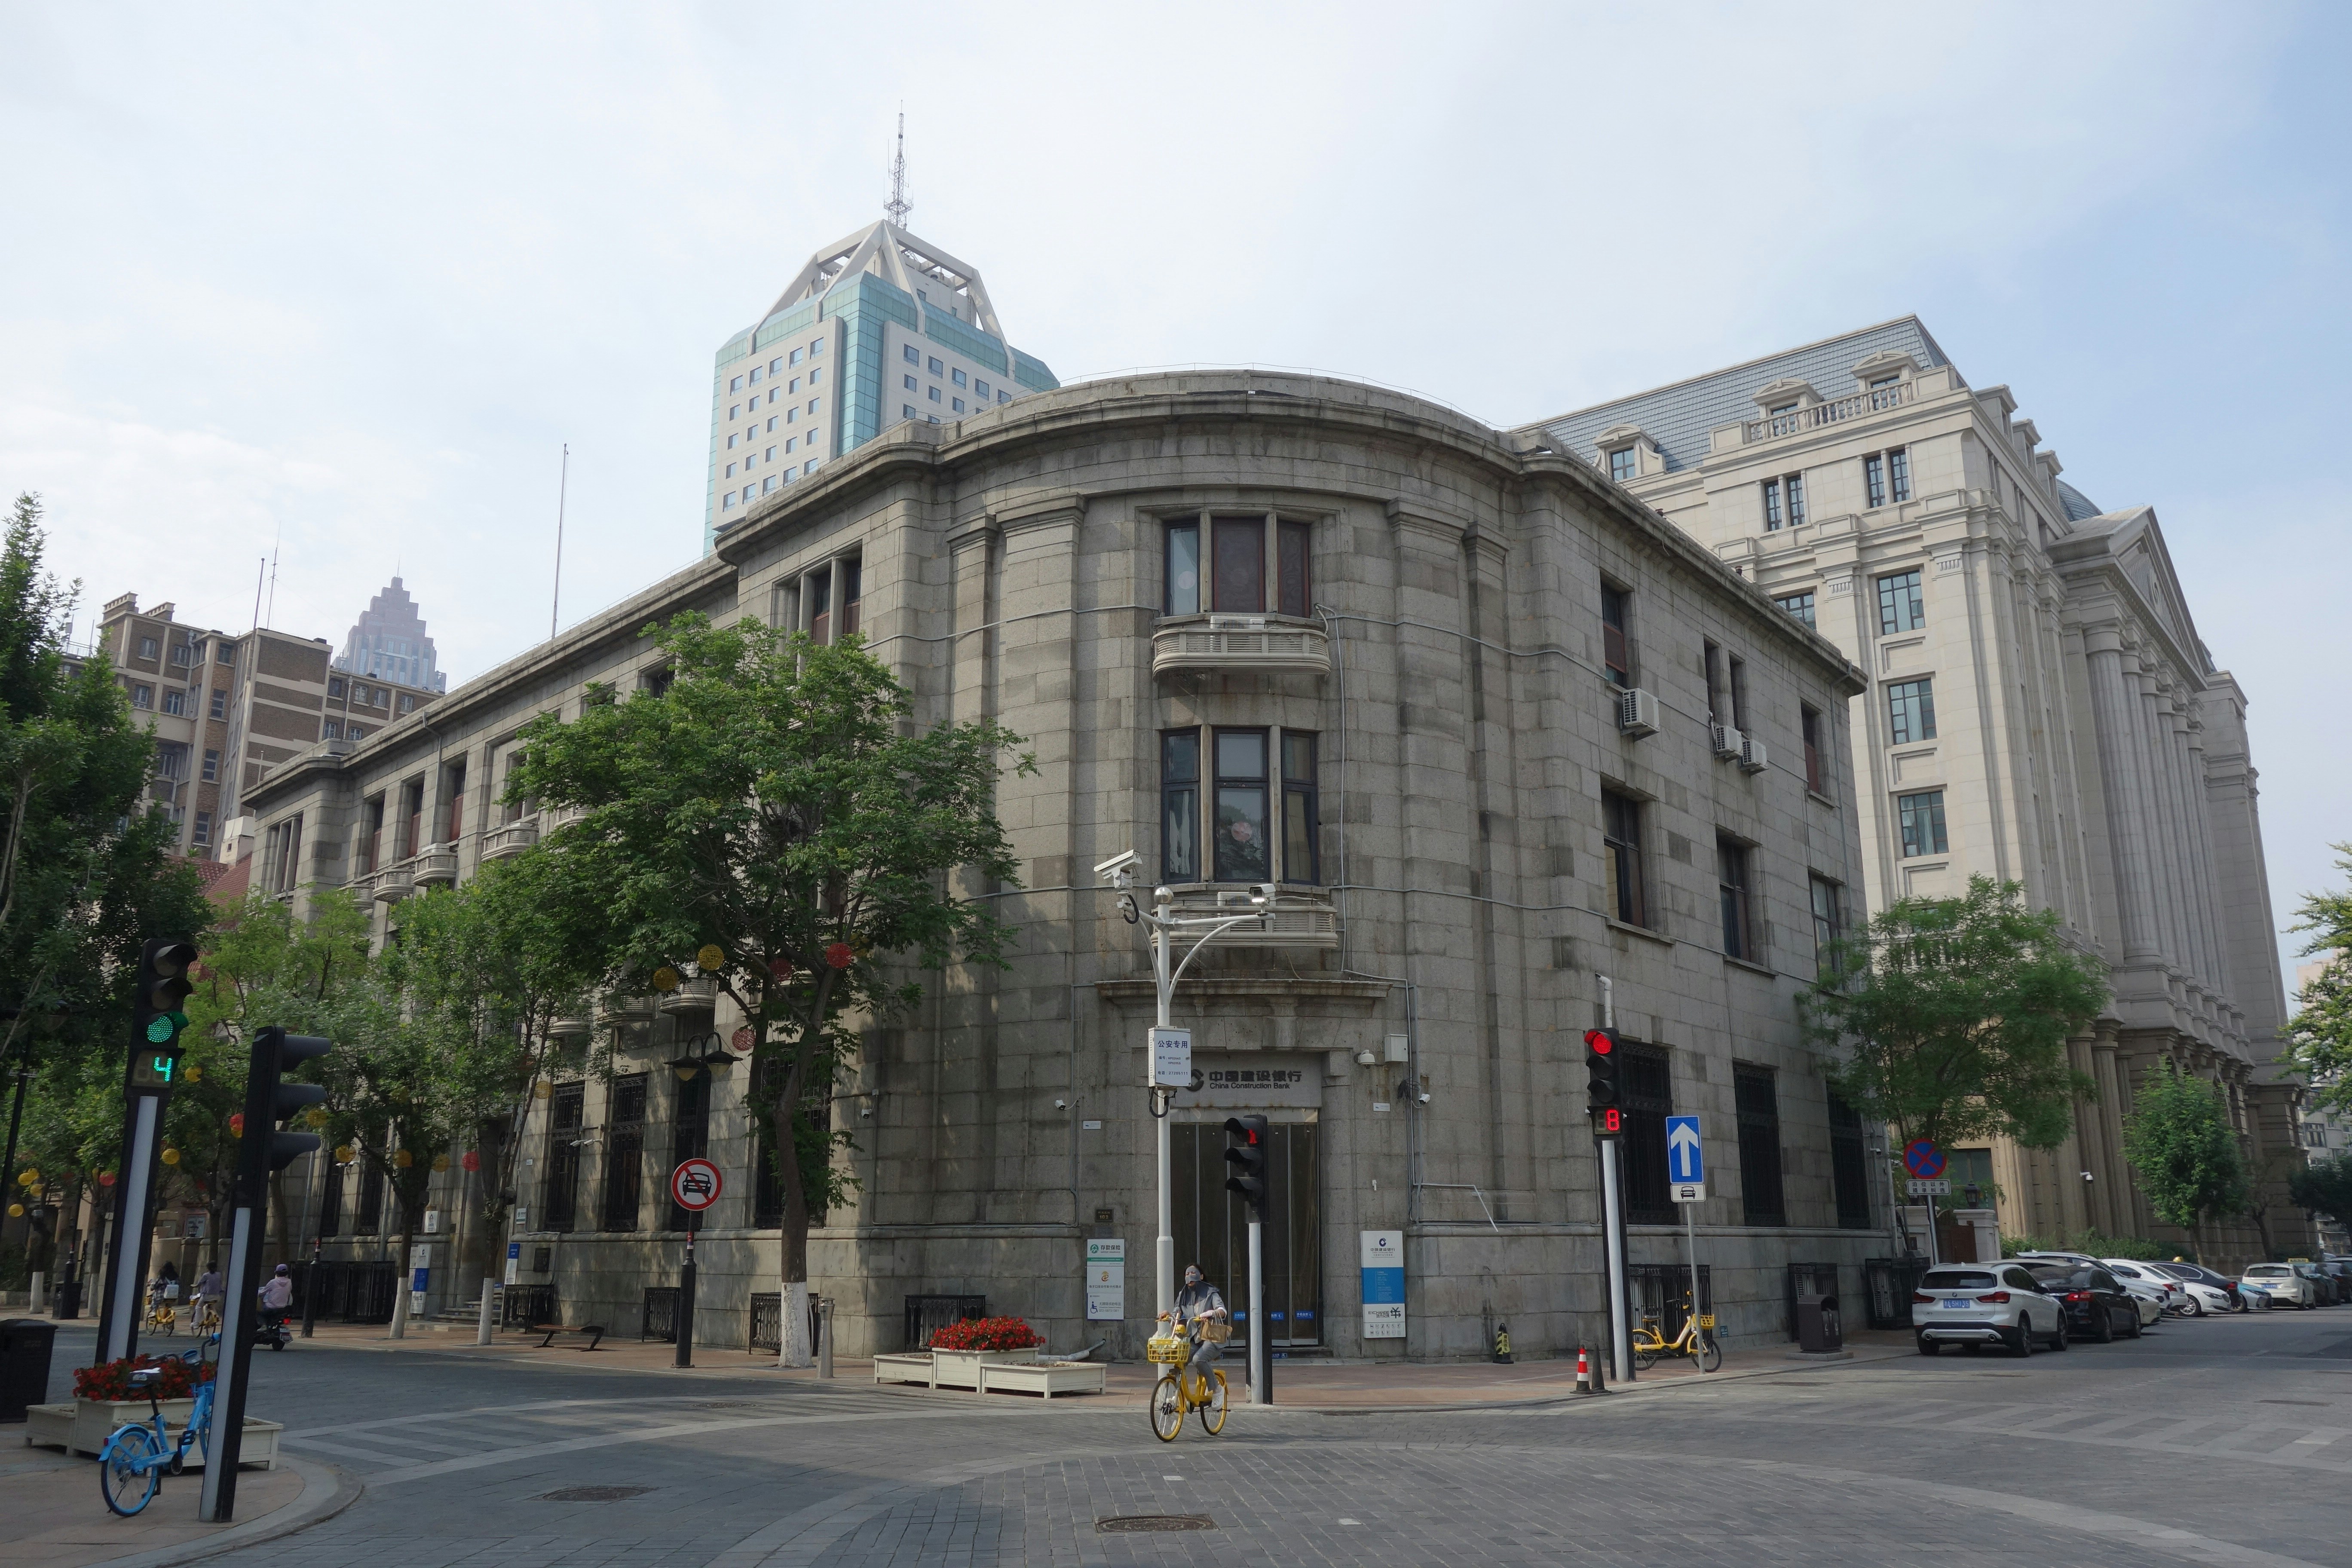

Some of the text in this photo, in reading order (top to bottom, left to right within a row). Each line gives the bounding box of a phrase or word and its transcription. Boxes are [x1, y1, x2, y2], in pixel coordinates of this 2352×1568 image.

[1158, 1040, 1188, 1048] 公安专用
[154, 1057, 172, 1082] 4
[1209, 1070, 1302, 1082] 中国建设银行
[1607, 1109, 1620, 1130] 8
